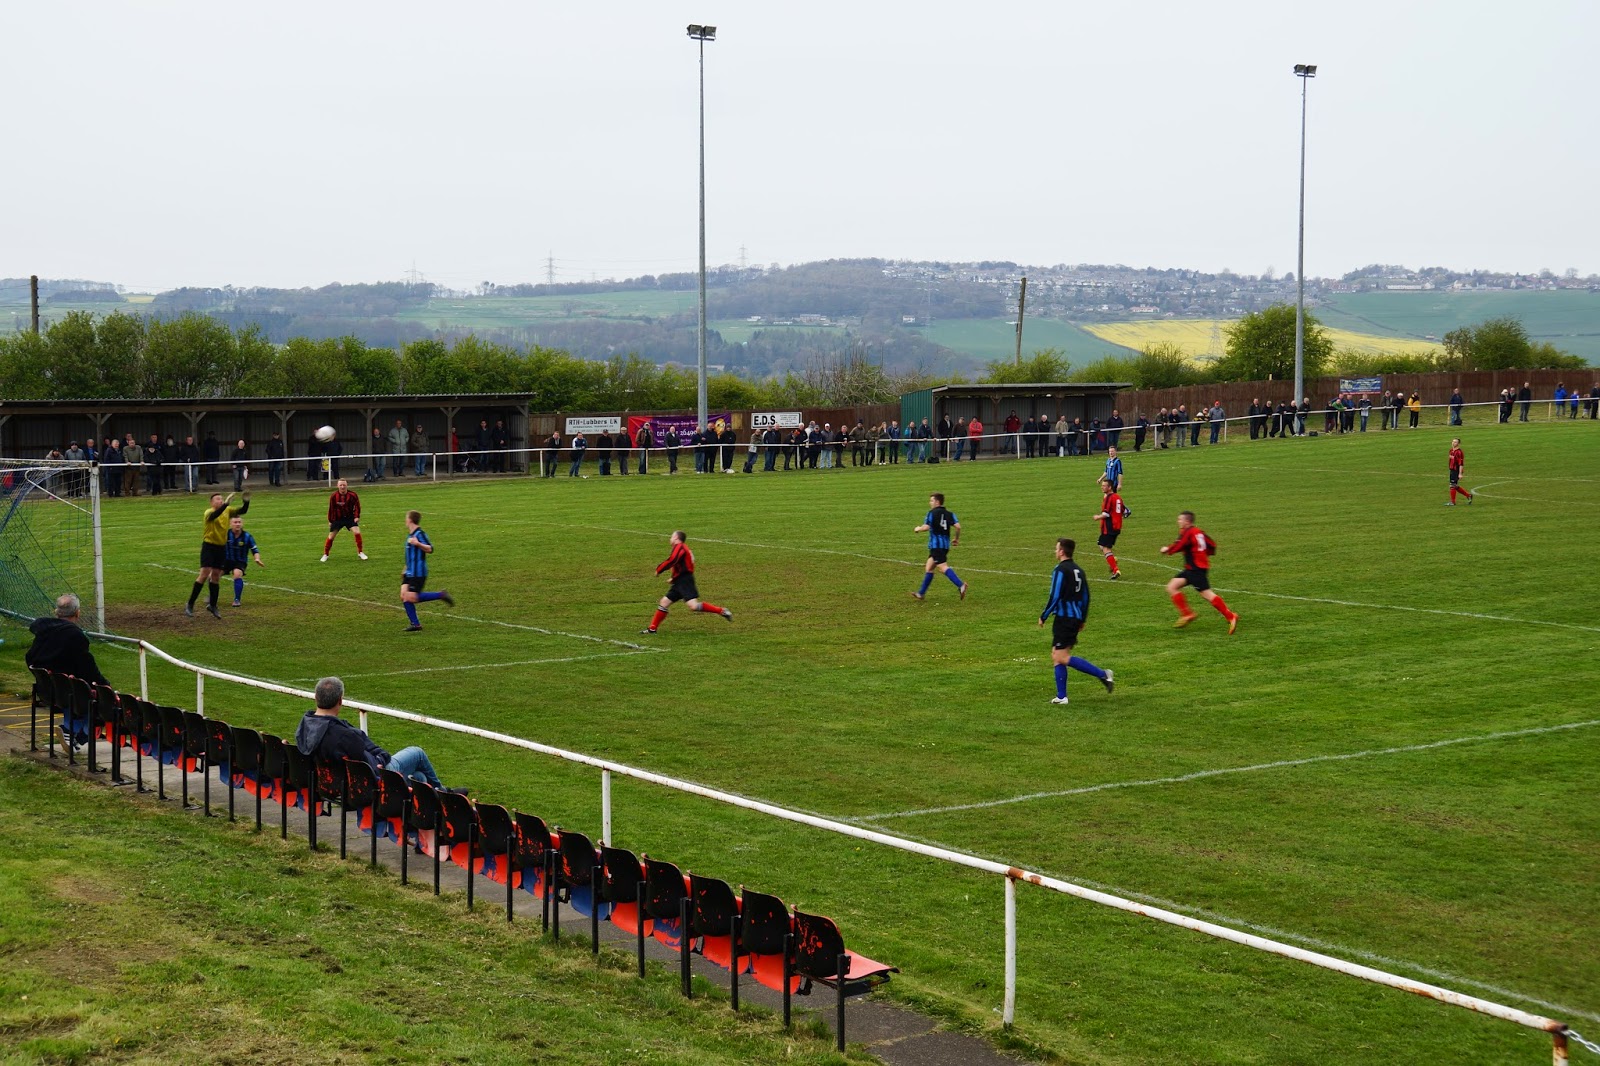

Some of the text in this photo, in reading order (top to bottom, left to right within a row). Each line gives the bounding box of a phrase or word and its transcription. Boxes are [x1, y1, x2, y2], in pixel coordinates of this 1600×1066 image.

[680, 429, 698, 437] 26490
[940, 514, 947, 530] 4
[1073, 569, 1082, 592] 5
